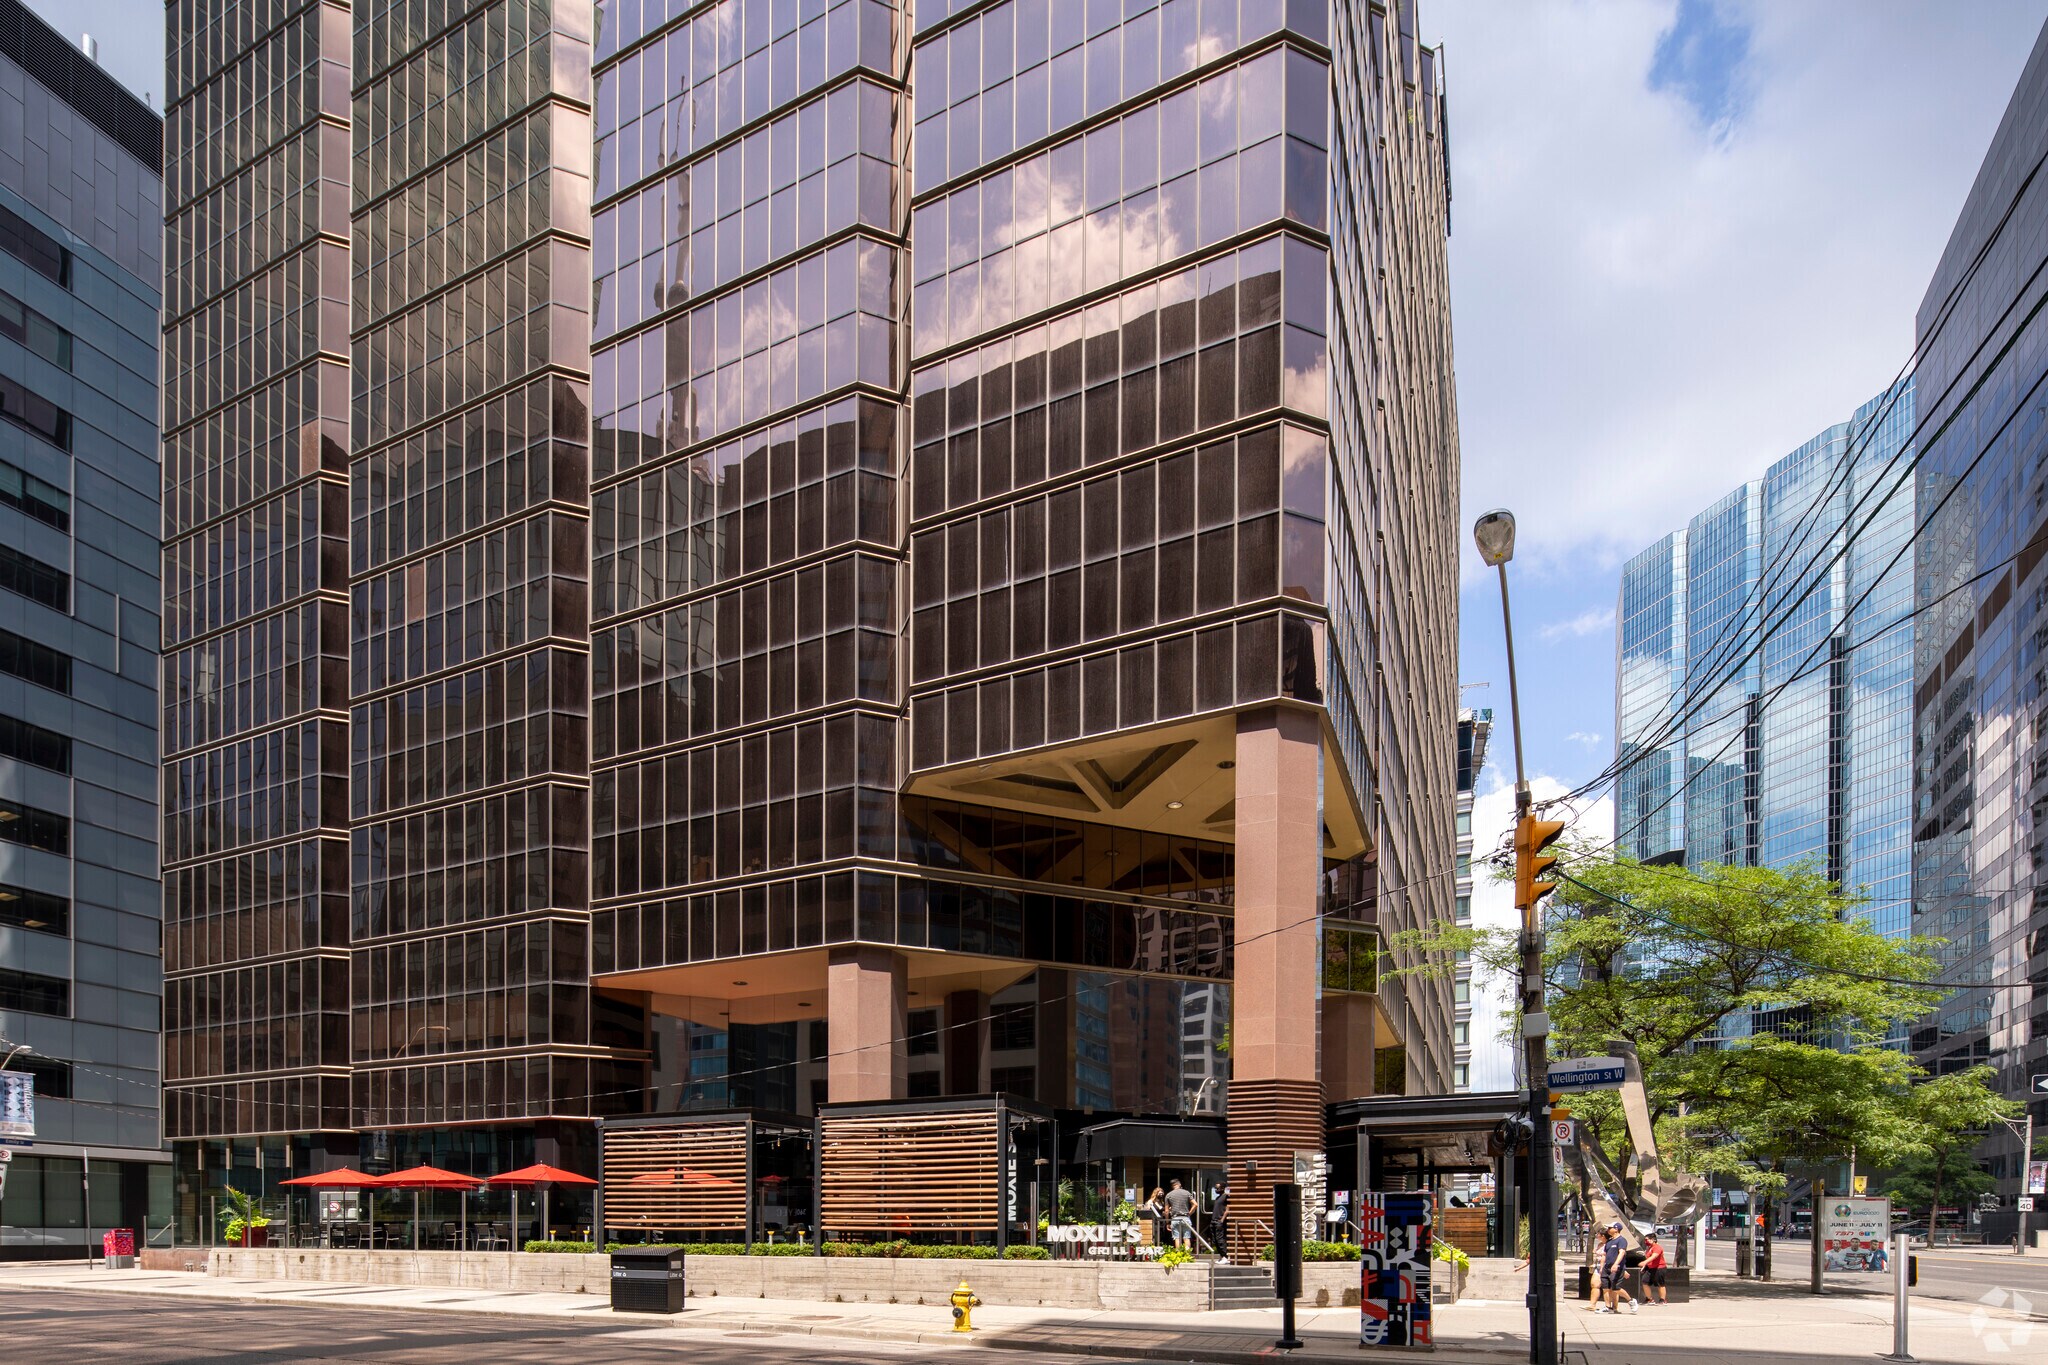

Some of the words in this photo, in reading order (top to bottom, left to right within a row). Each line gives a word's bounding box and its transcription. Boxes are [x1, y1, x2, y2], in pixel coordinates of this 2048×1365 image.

[1551, 1072, 1600, 1084] Wellington
[1604, 1071, 1612, 1080] St
[1614, 1068, 1623, 1079] W
[1047, 1222, 1143, 1243] MOXIE'S
[1088, 1246, 1129, 1256] GRILL
[1135, 1246, 1167, 1256] BAR
